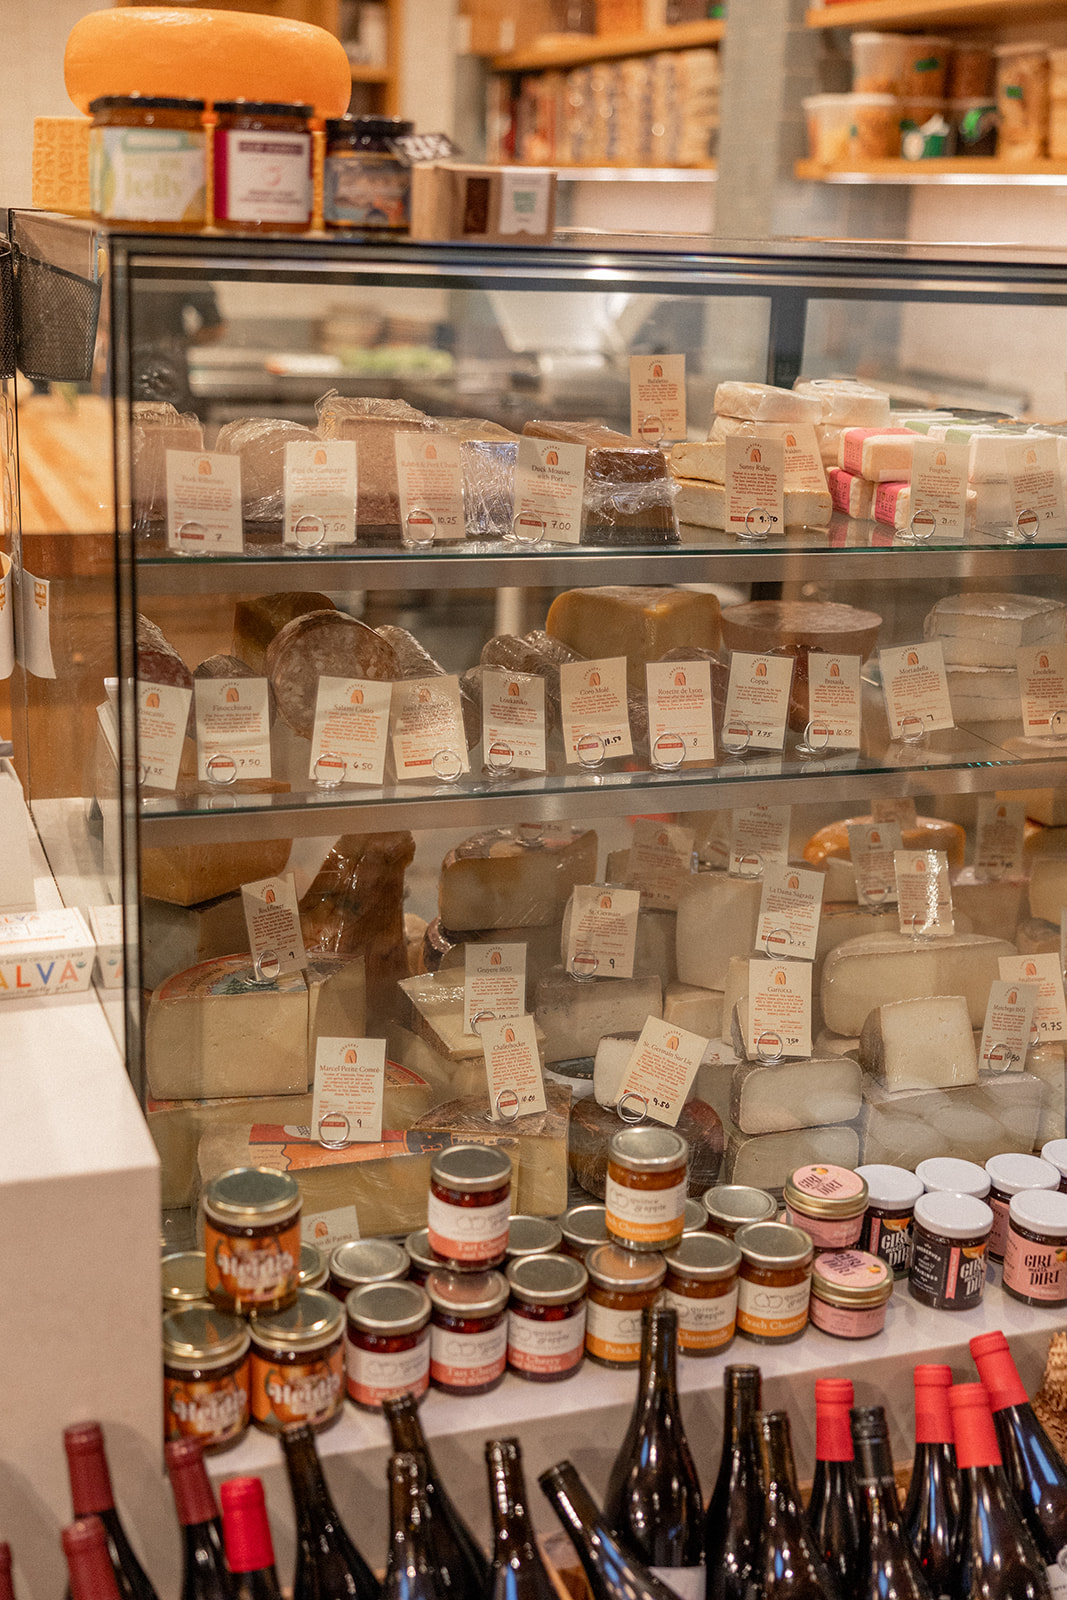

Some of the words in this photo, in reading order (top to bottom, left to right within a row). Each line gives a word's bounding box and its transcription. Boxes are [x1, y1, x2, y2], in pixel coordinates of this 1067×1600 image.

[532, 464, 546, 472] Duck
[548, 467, 570, 476] Mousse
[437, 516, 458, 525] 10.25
[551, 520, 572, 530] 7.00
[750, 677, 769, 686] Coppa
[239, 758, 261, 767] 7.50
[352, 761, 374, 770] 6.50
[609, 958, 615, 968] 9
[1040, 1022, 1062, 1032] 9.75
[320, 1064, 340, 1072] Marcel
[652, 1097, 670, 1109] 9.50
[356, 1118, 362, 1128] 9
[1024, 1254, 1052, 1268] GIRL
[1030, 1270, 1060, 1286] DIRT
[742, 1315, 766, 1329] Peach
[604, 1343, 632, 1355] Peach
